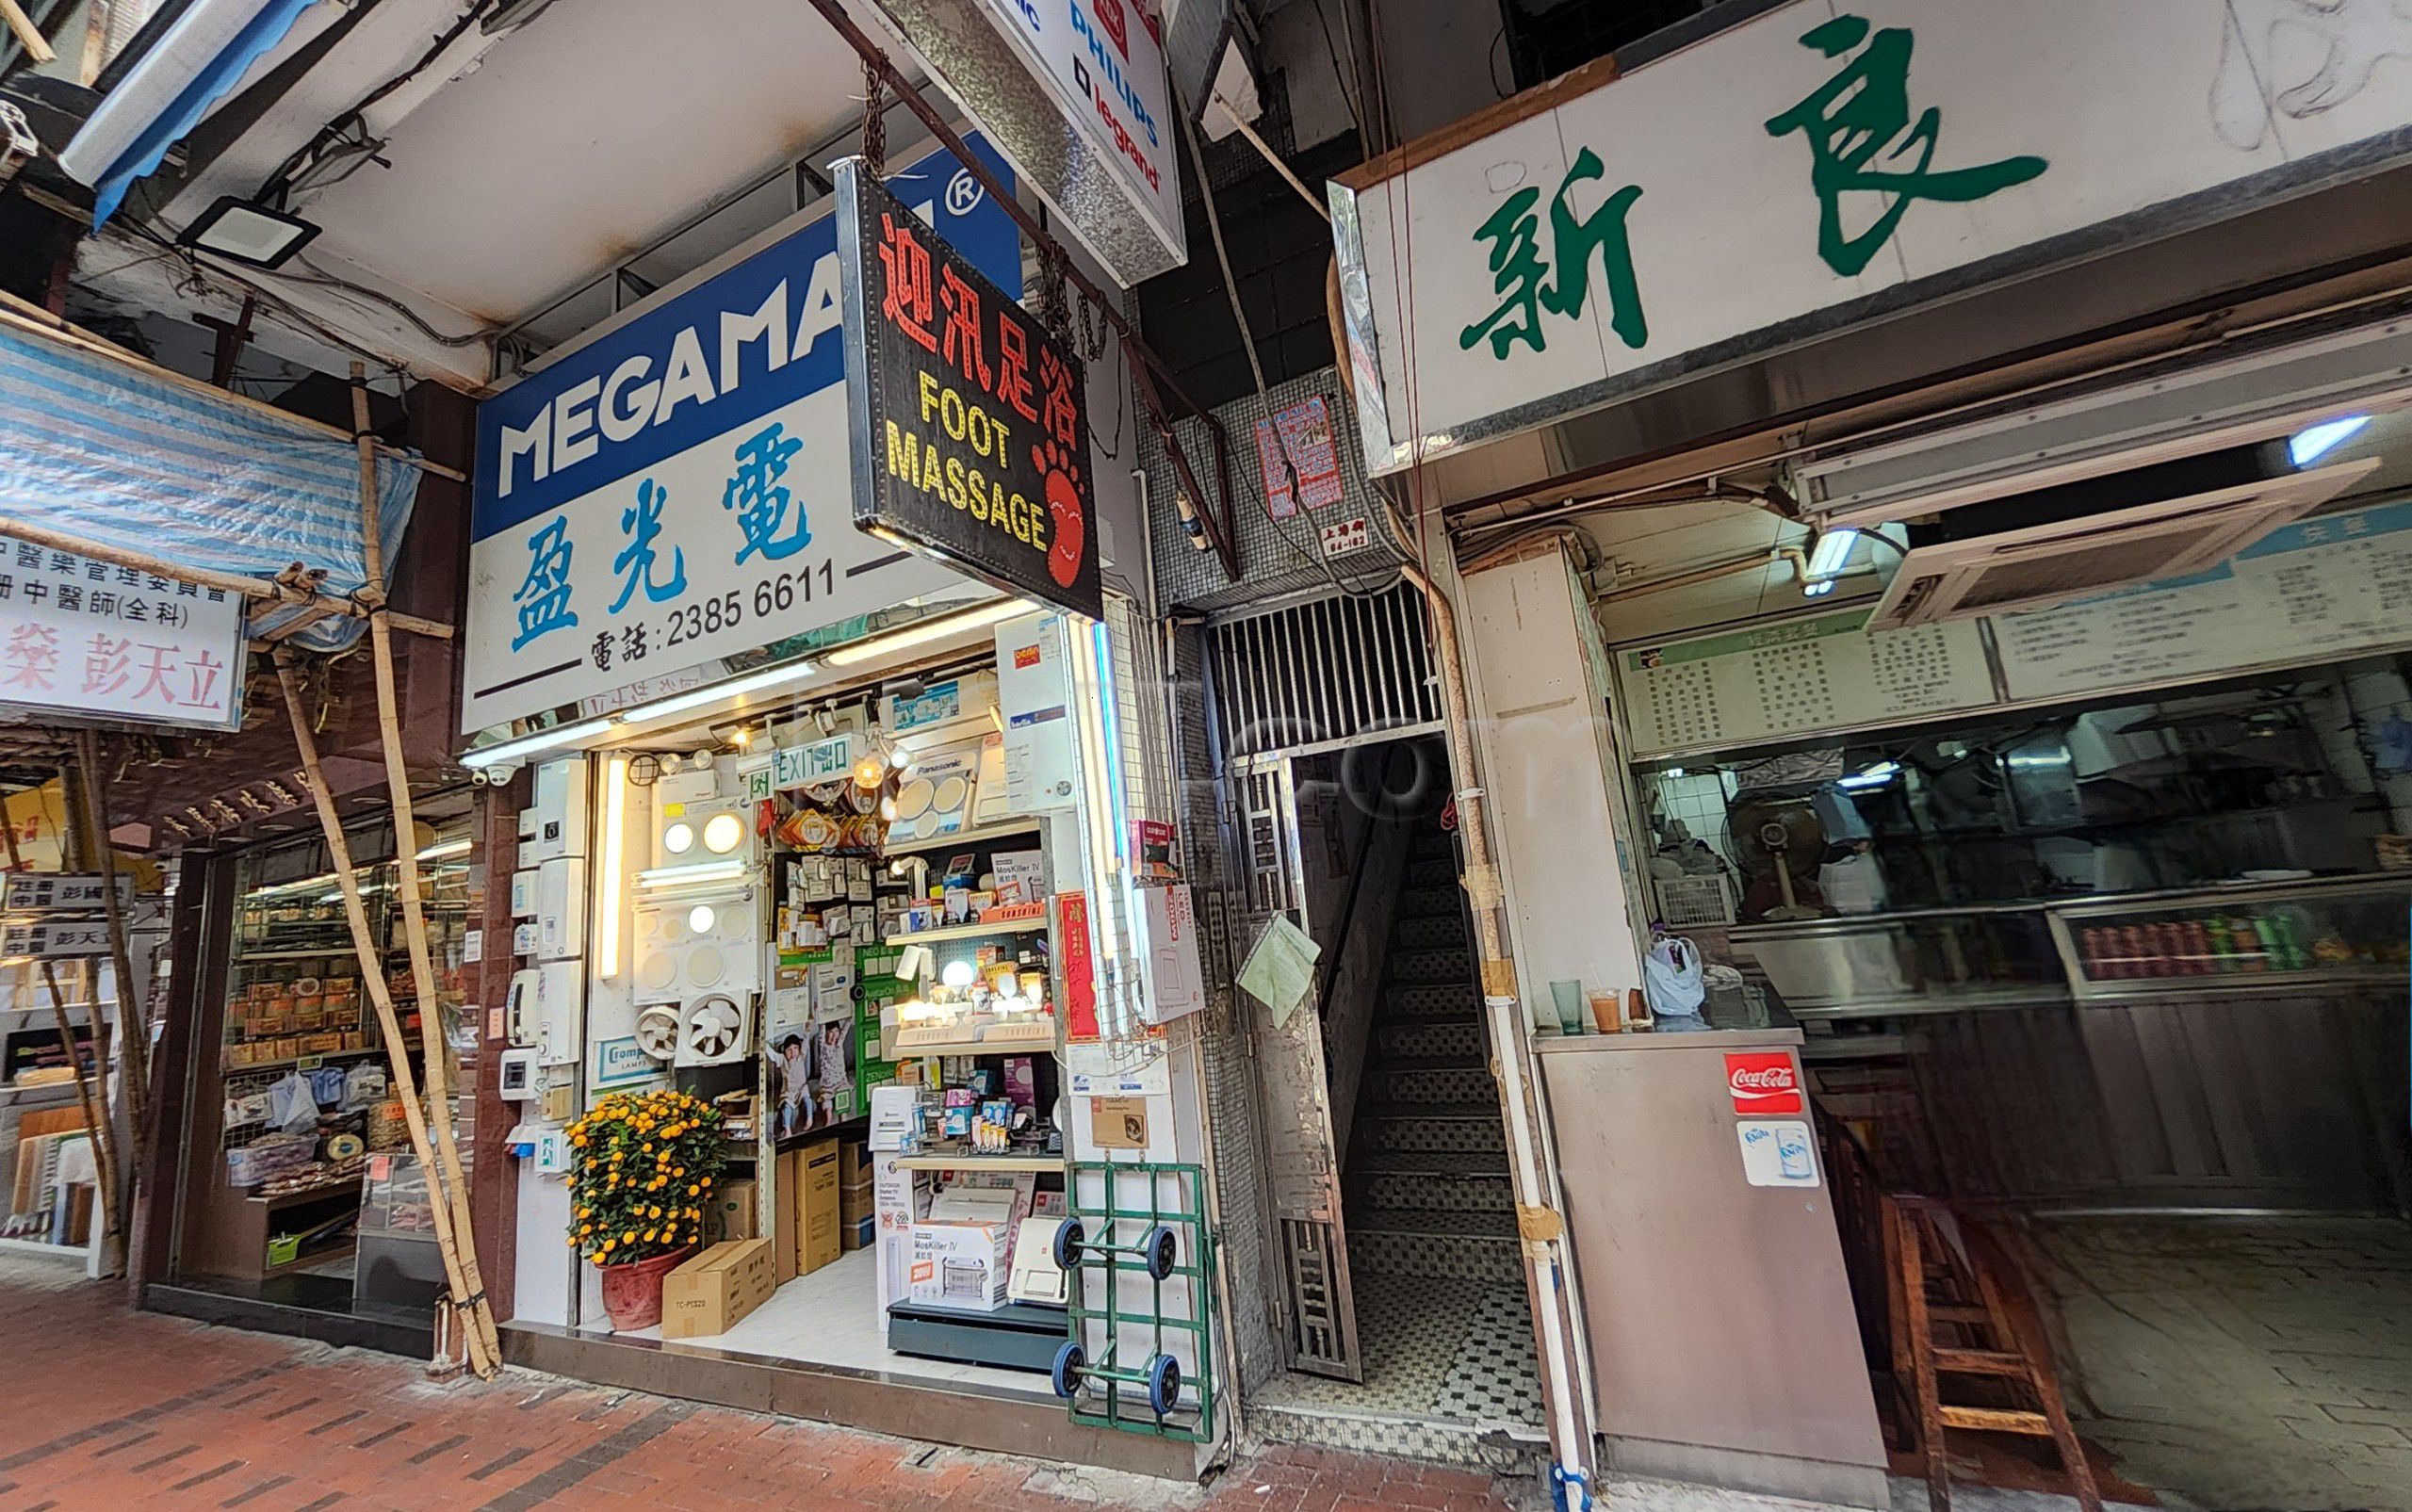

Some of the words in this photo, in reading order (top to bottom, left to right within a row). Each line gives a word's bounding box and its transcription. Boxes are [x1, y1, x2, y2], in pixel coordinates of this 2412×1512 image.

[1095, 83, 1160, 195] legrand
[497, 200, 935, 500] MEGAMA
[920, 370, 1011, 469] FOOT
[887, 422, 1048, 552] MASSAGE
[666, 591, 742, 648] 2385
[753, 559, 836, 619] 6611
[917, 757, 963, 776] Panasonic
[621, 1060, 647, 1070] LAMPS
[914, 1240, 947, 1251] MosKiller
